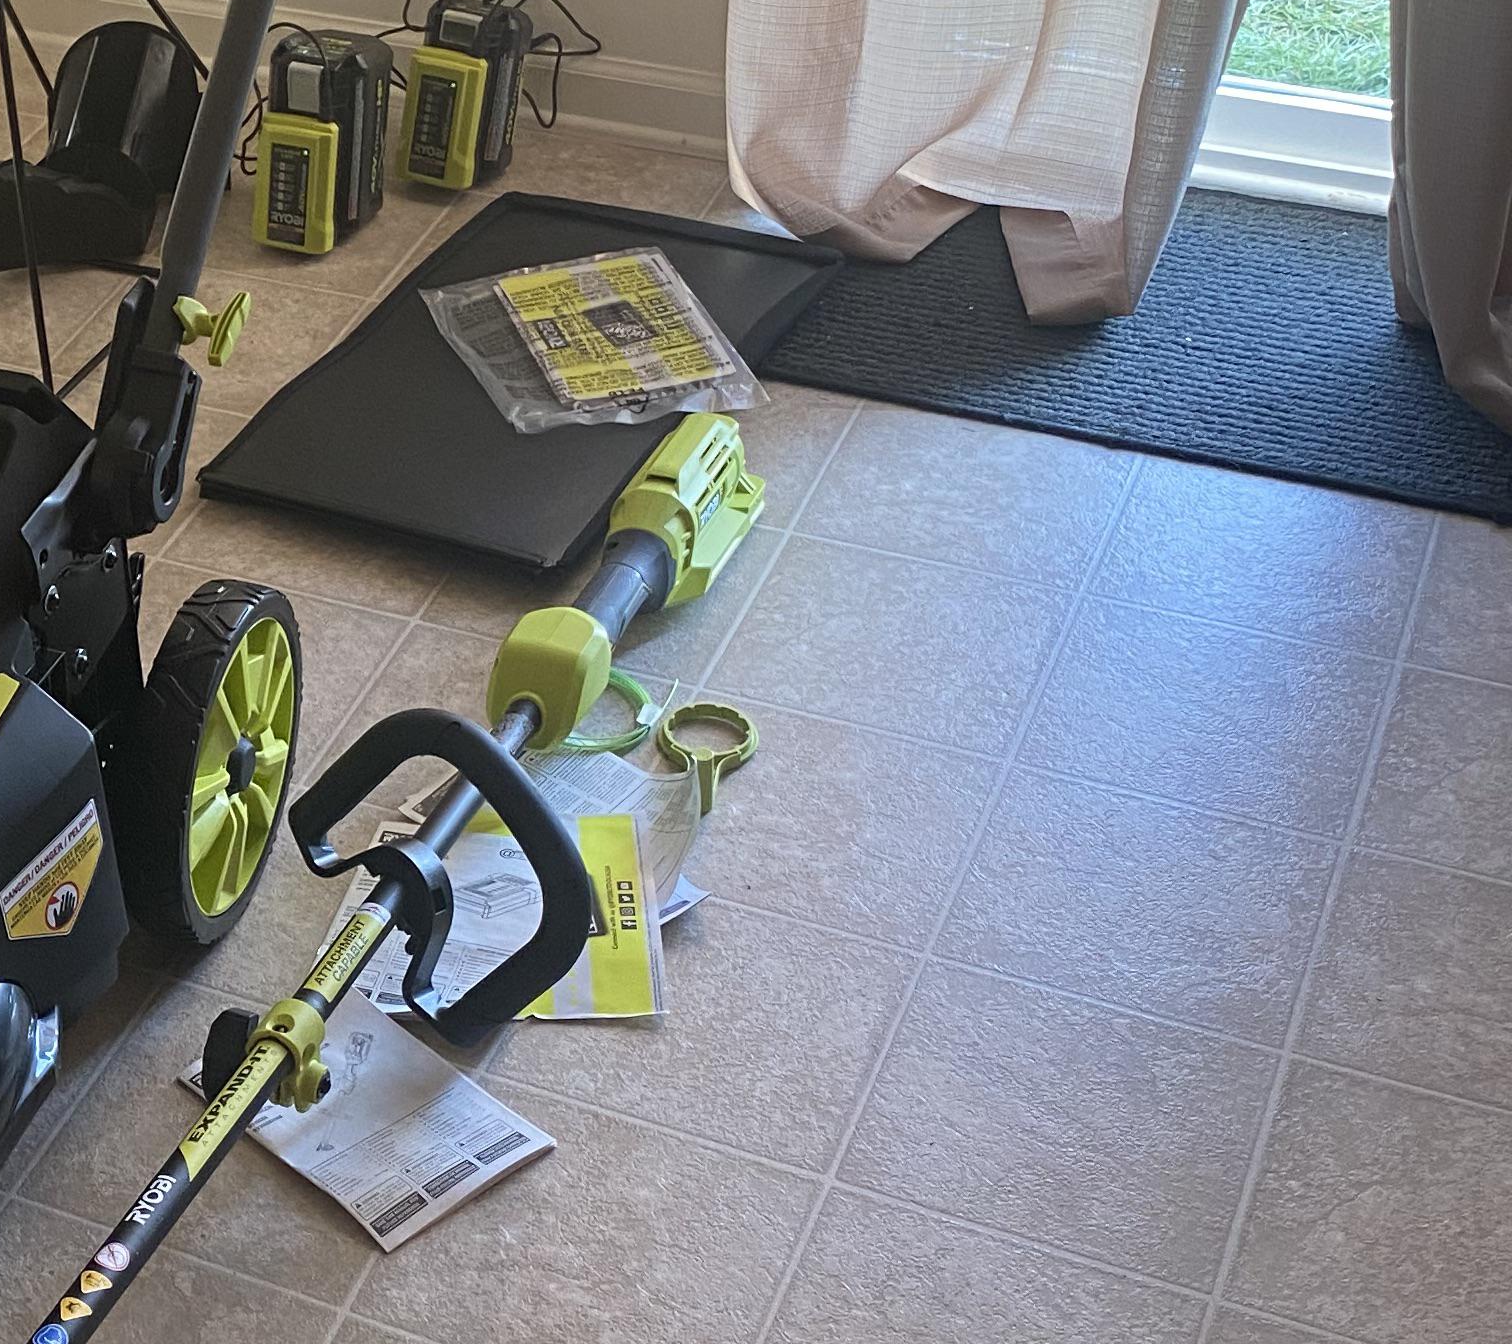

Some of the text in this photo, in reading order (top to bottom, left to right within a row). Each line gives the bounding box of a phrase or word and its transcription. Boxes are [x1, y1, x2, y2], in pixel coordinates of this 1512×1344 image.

[270, 211, 304, 227] RYOBI
[314, 920, 365, 986] ATTACHMENT
[332, 934, 369, 982] CAPABLE
[188, 1045, 268, 1143] EXPAND-IT
[124, 1174, 177, 1226] RYOBI
